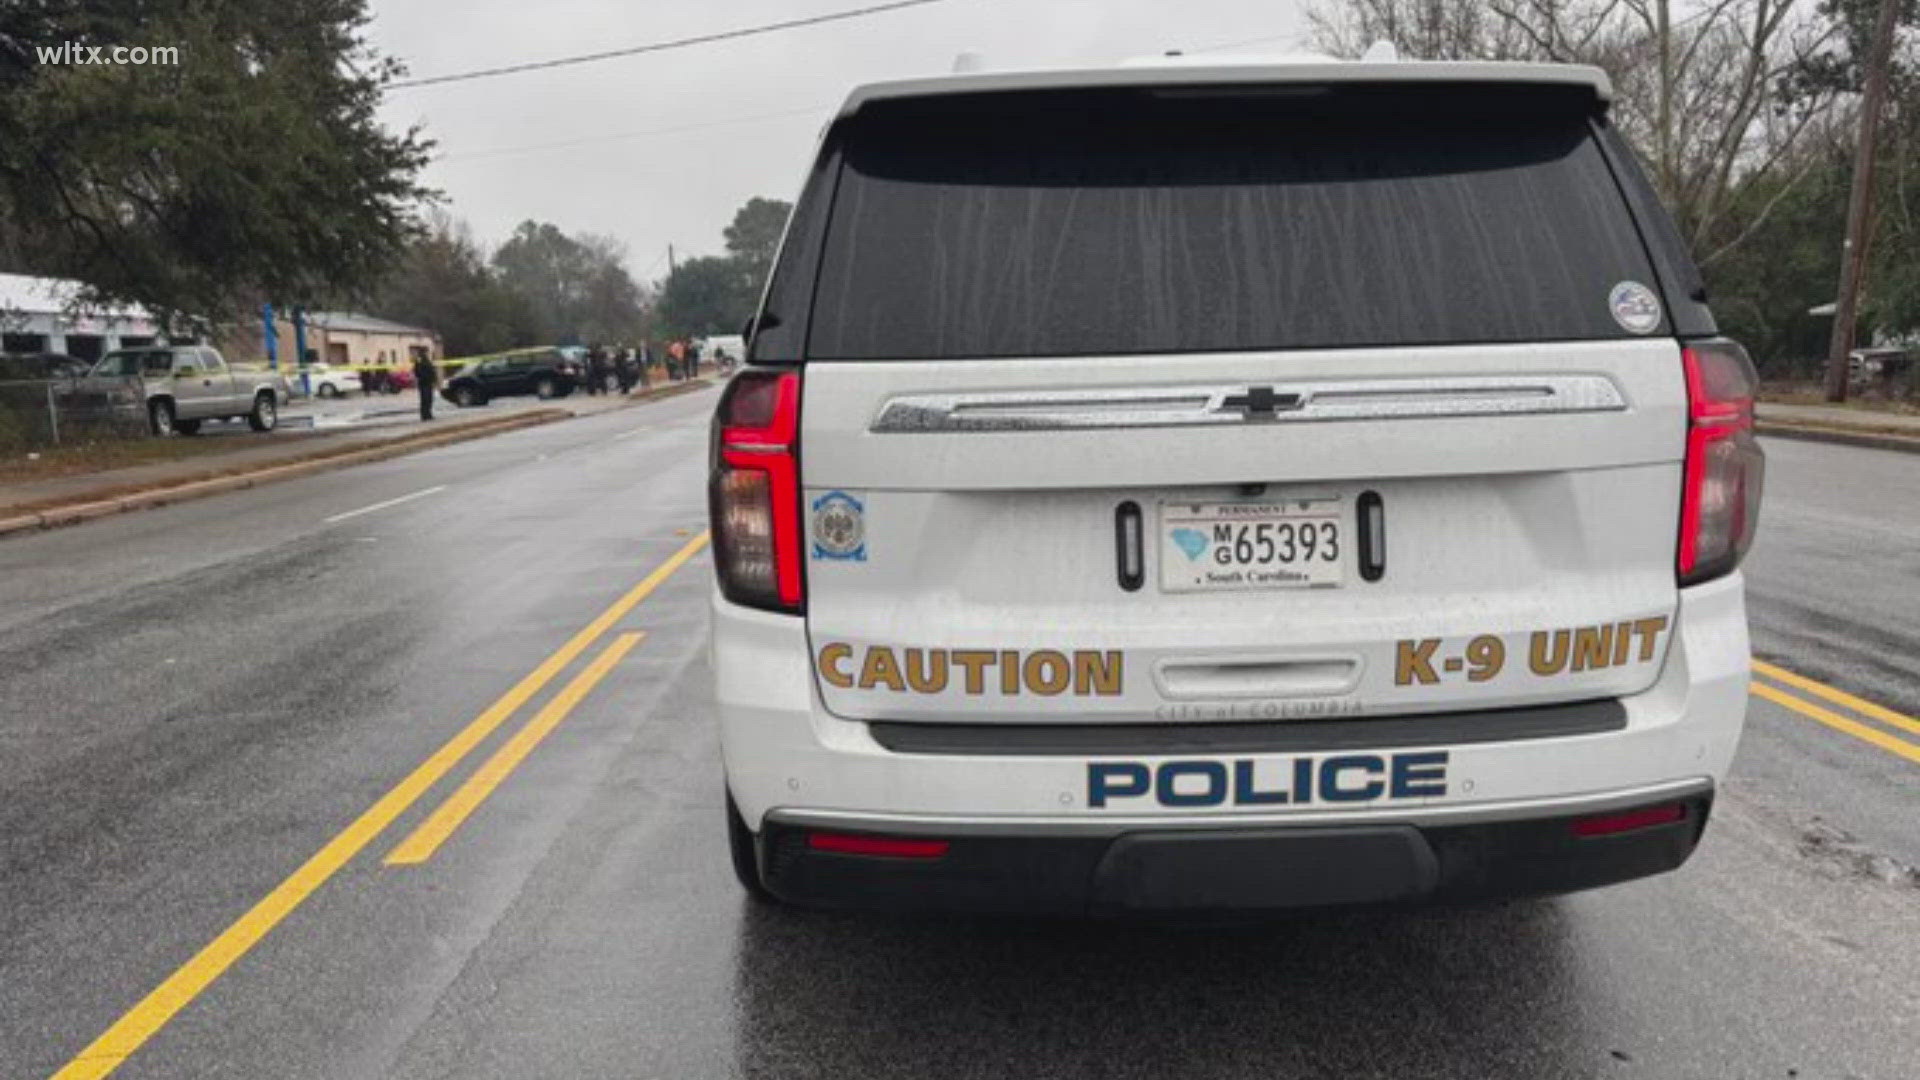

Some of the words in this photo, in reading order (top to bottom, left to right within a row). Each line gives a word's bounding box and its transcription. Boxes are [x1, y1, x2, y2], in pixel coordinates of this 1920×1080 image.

[1206, 570, 1243, 582] South
[1247, 569, 1303, 582] Carolina
[818, 642, 1124, 696] CAUTION
[1394, 634, 1506, 686] K-9
[1528, 615, 1668, 677] UNIT
[1087, 751, 1450, 809] POLICE
